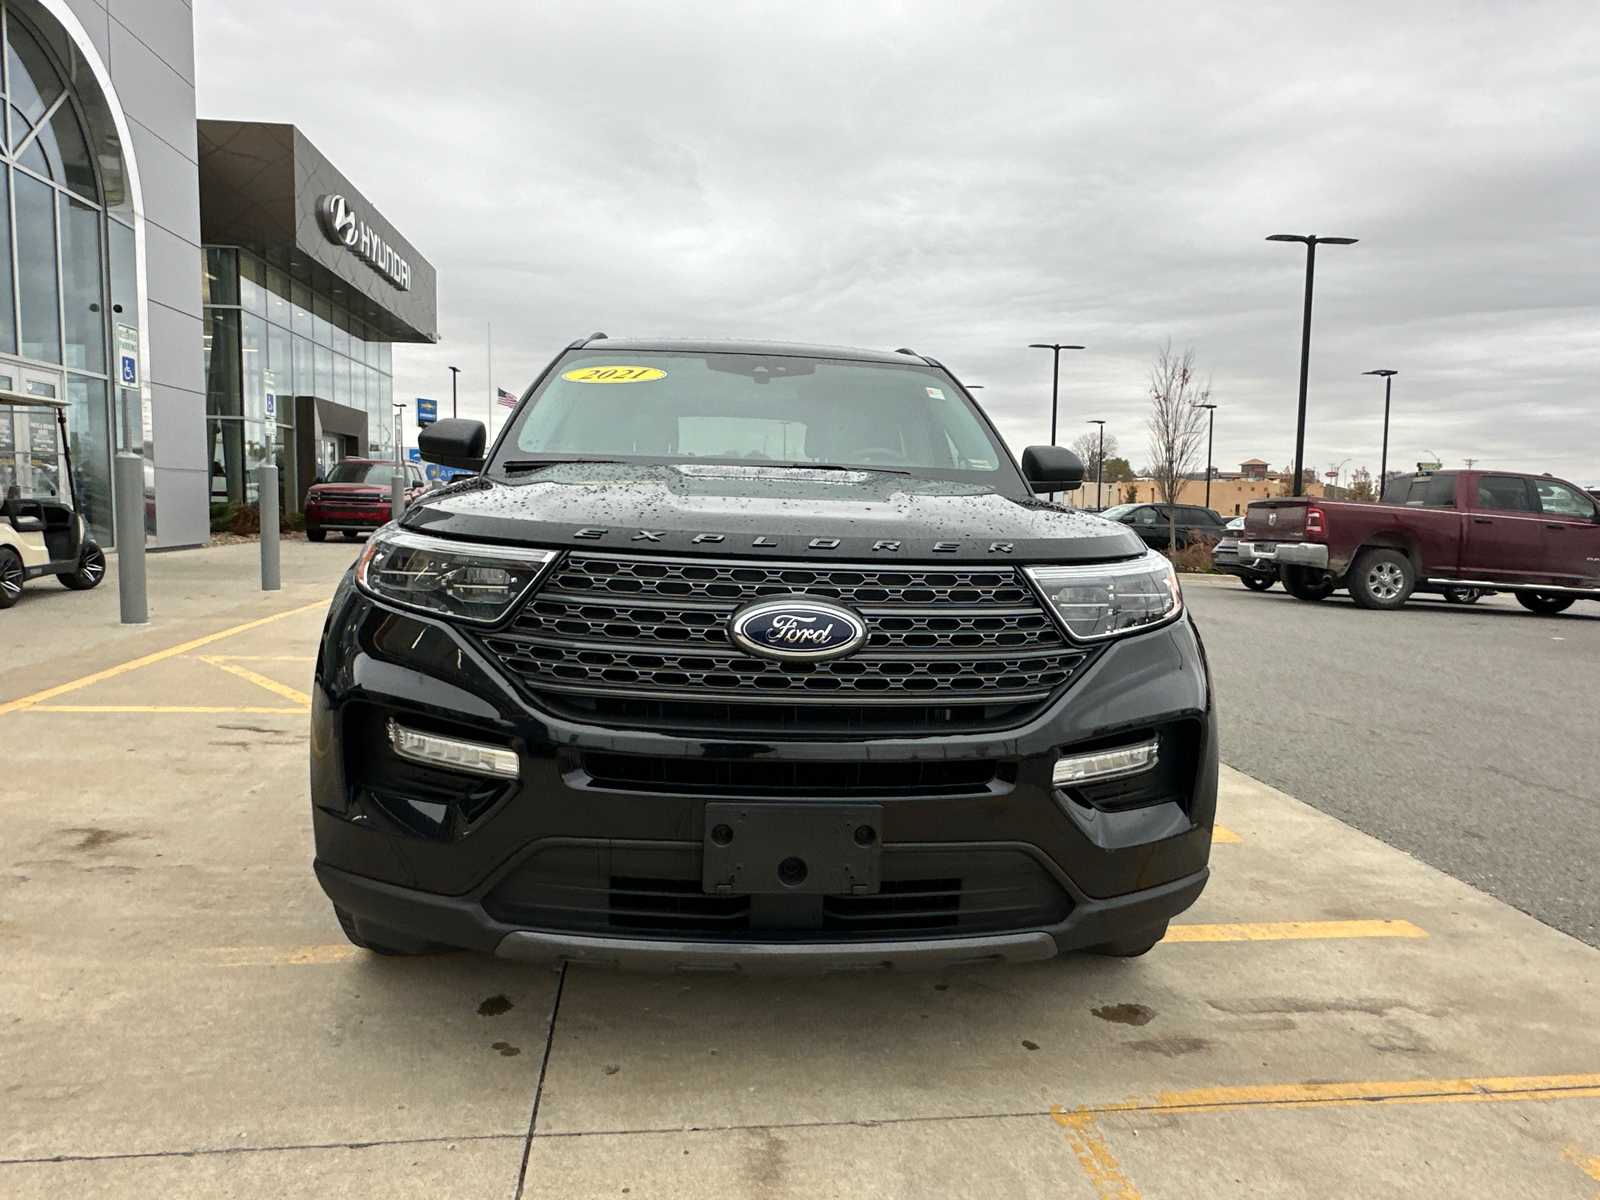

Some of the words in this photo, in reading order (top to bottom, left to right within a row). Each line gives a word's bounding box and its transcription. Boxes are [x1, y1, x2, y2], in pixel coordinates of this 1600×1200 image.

[360, 220, 411, 291] HYUNDAI
[579, 368, 651, 380] 2021
[573, 527, 1014, 554] EXPLORER
[766, 614, 834, 644] Ford
